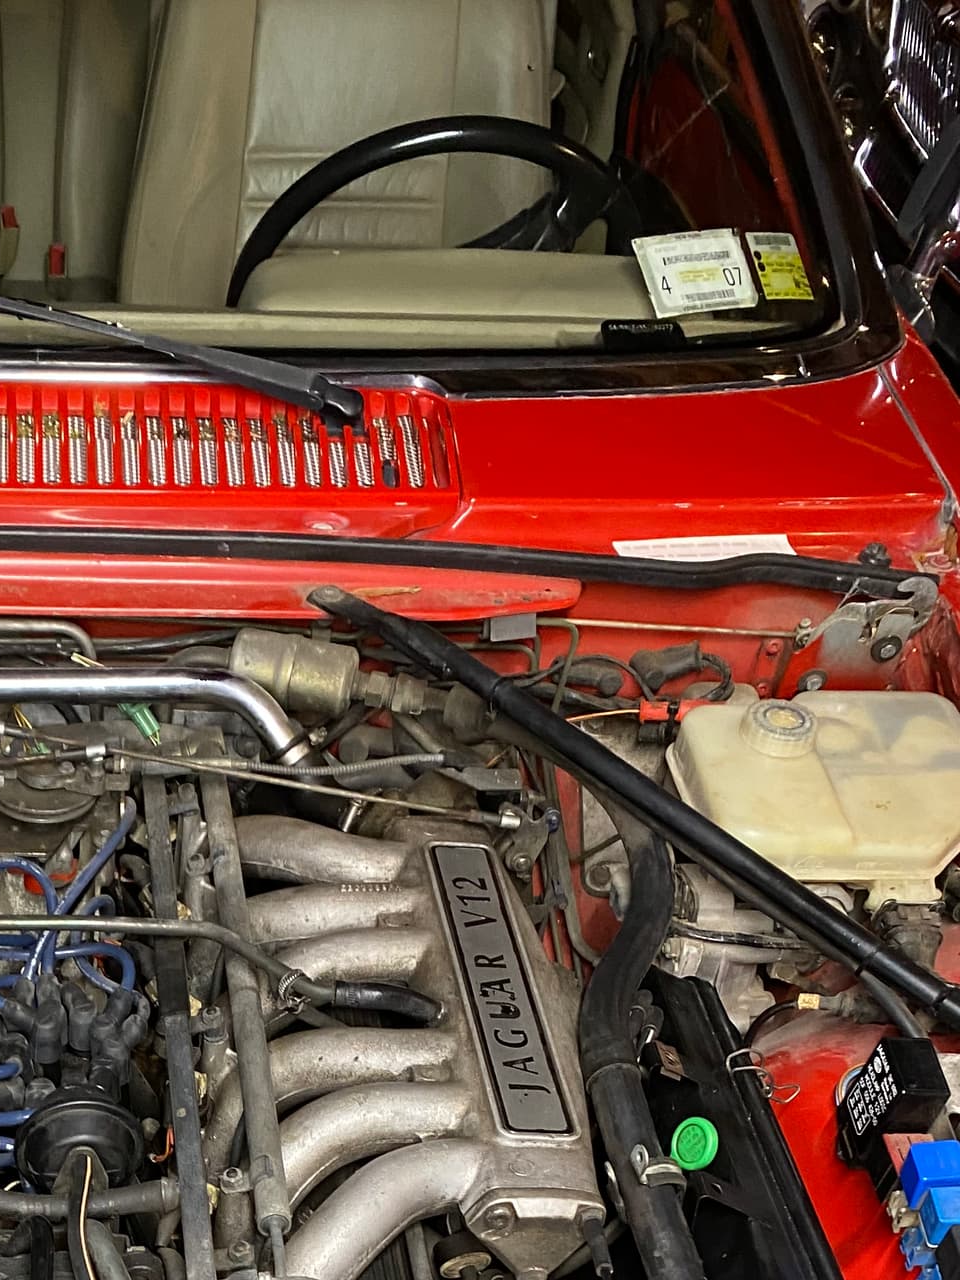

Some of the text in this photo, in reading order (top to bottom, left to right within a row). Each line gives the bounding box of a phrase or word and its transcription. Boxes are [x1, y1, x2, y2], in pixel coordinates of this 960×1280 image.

[661, 275, 672, 295] 4
[722, 267, 741, 287] 07
[452, 876, 551, 1095] JAGUAR V12
